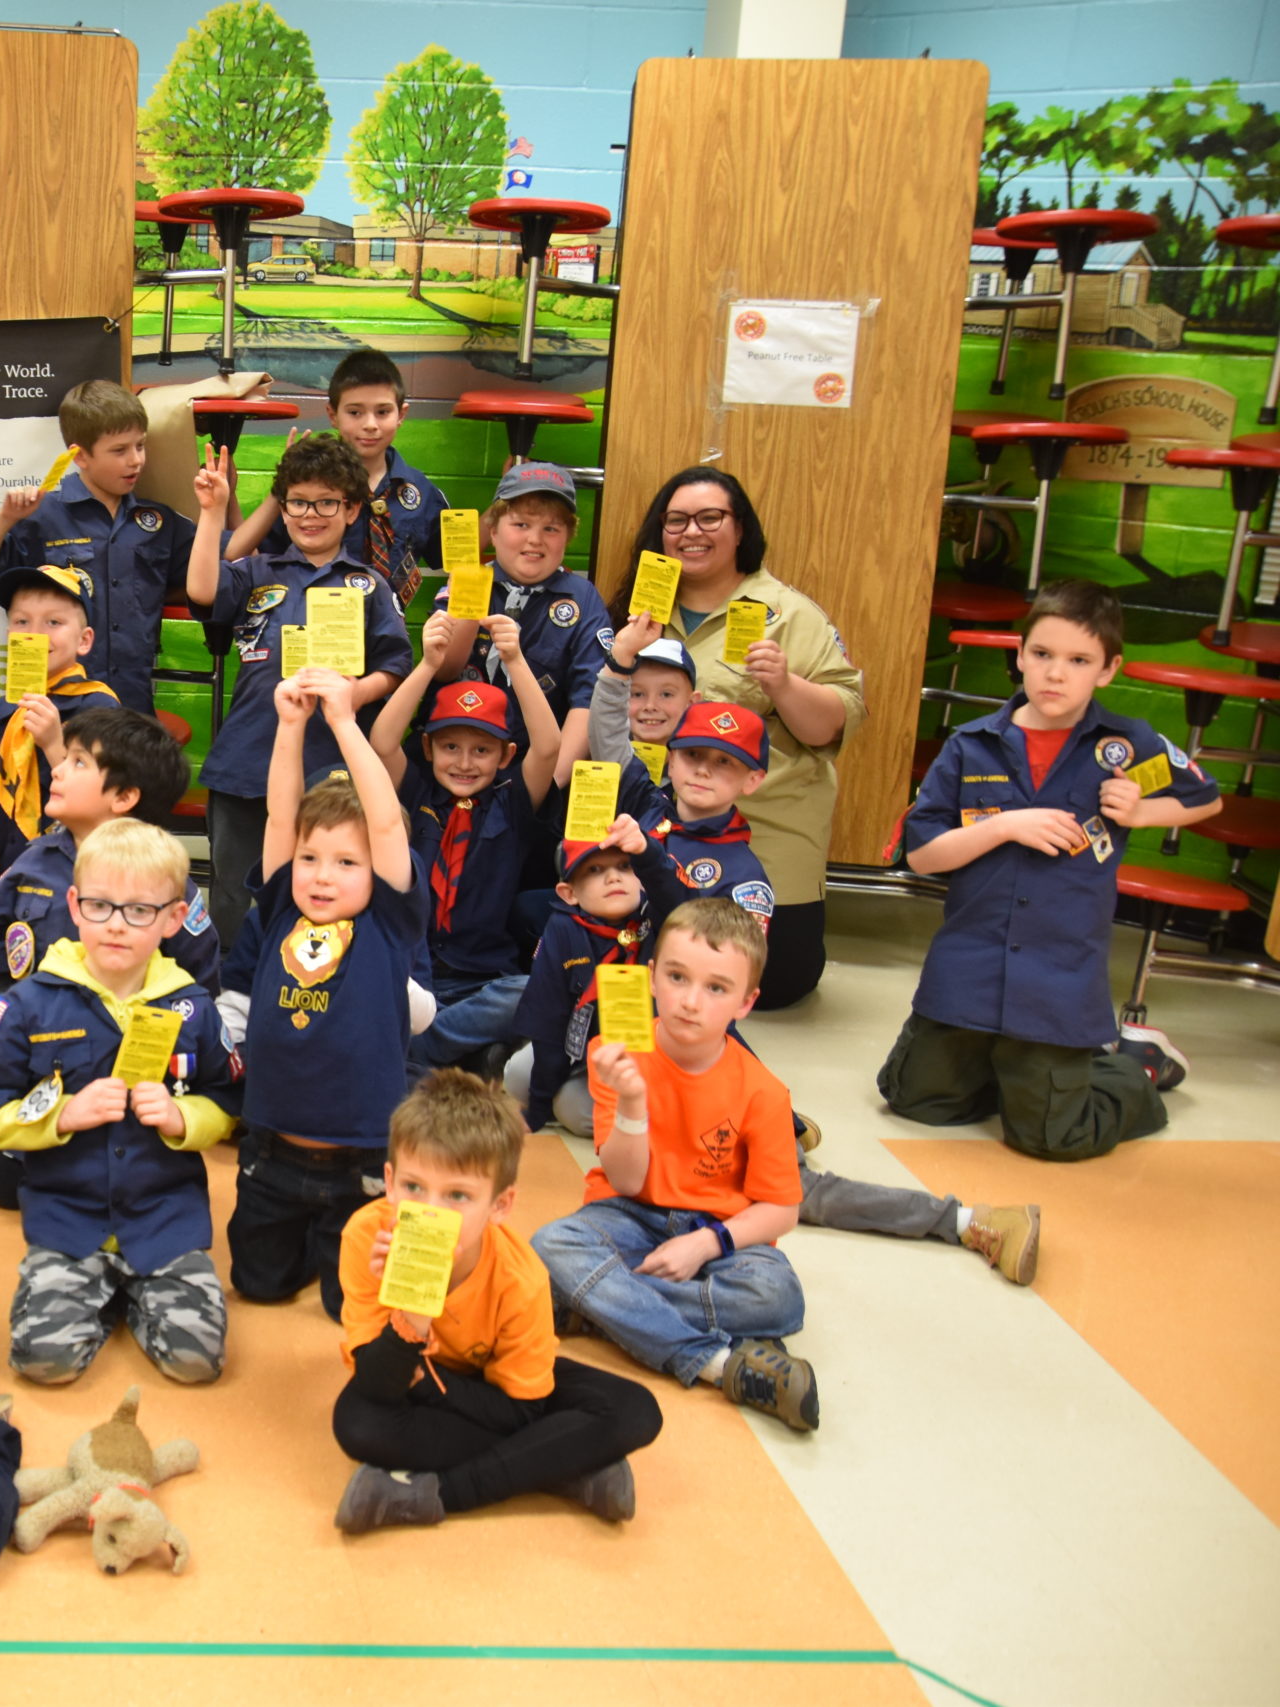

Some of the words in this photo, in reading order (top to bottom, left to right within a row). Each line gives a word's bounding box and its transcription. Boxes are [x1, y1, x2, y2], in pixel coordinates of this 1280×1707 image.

[747, 351, 781, 361] Peanut
[783, 352, 805, 362] Free
[808, 353, 833, 363] Table
[4, 363, 55, 378] World.
[2, 385, 48, 399] Trace.
[279, 986, 329, 1013] LION
